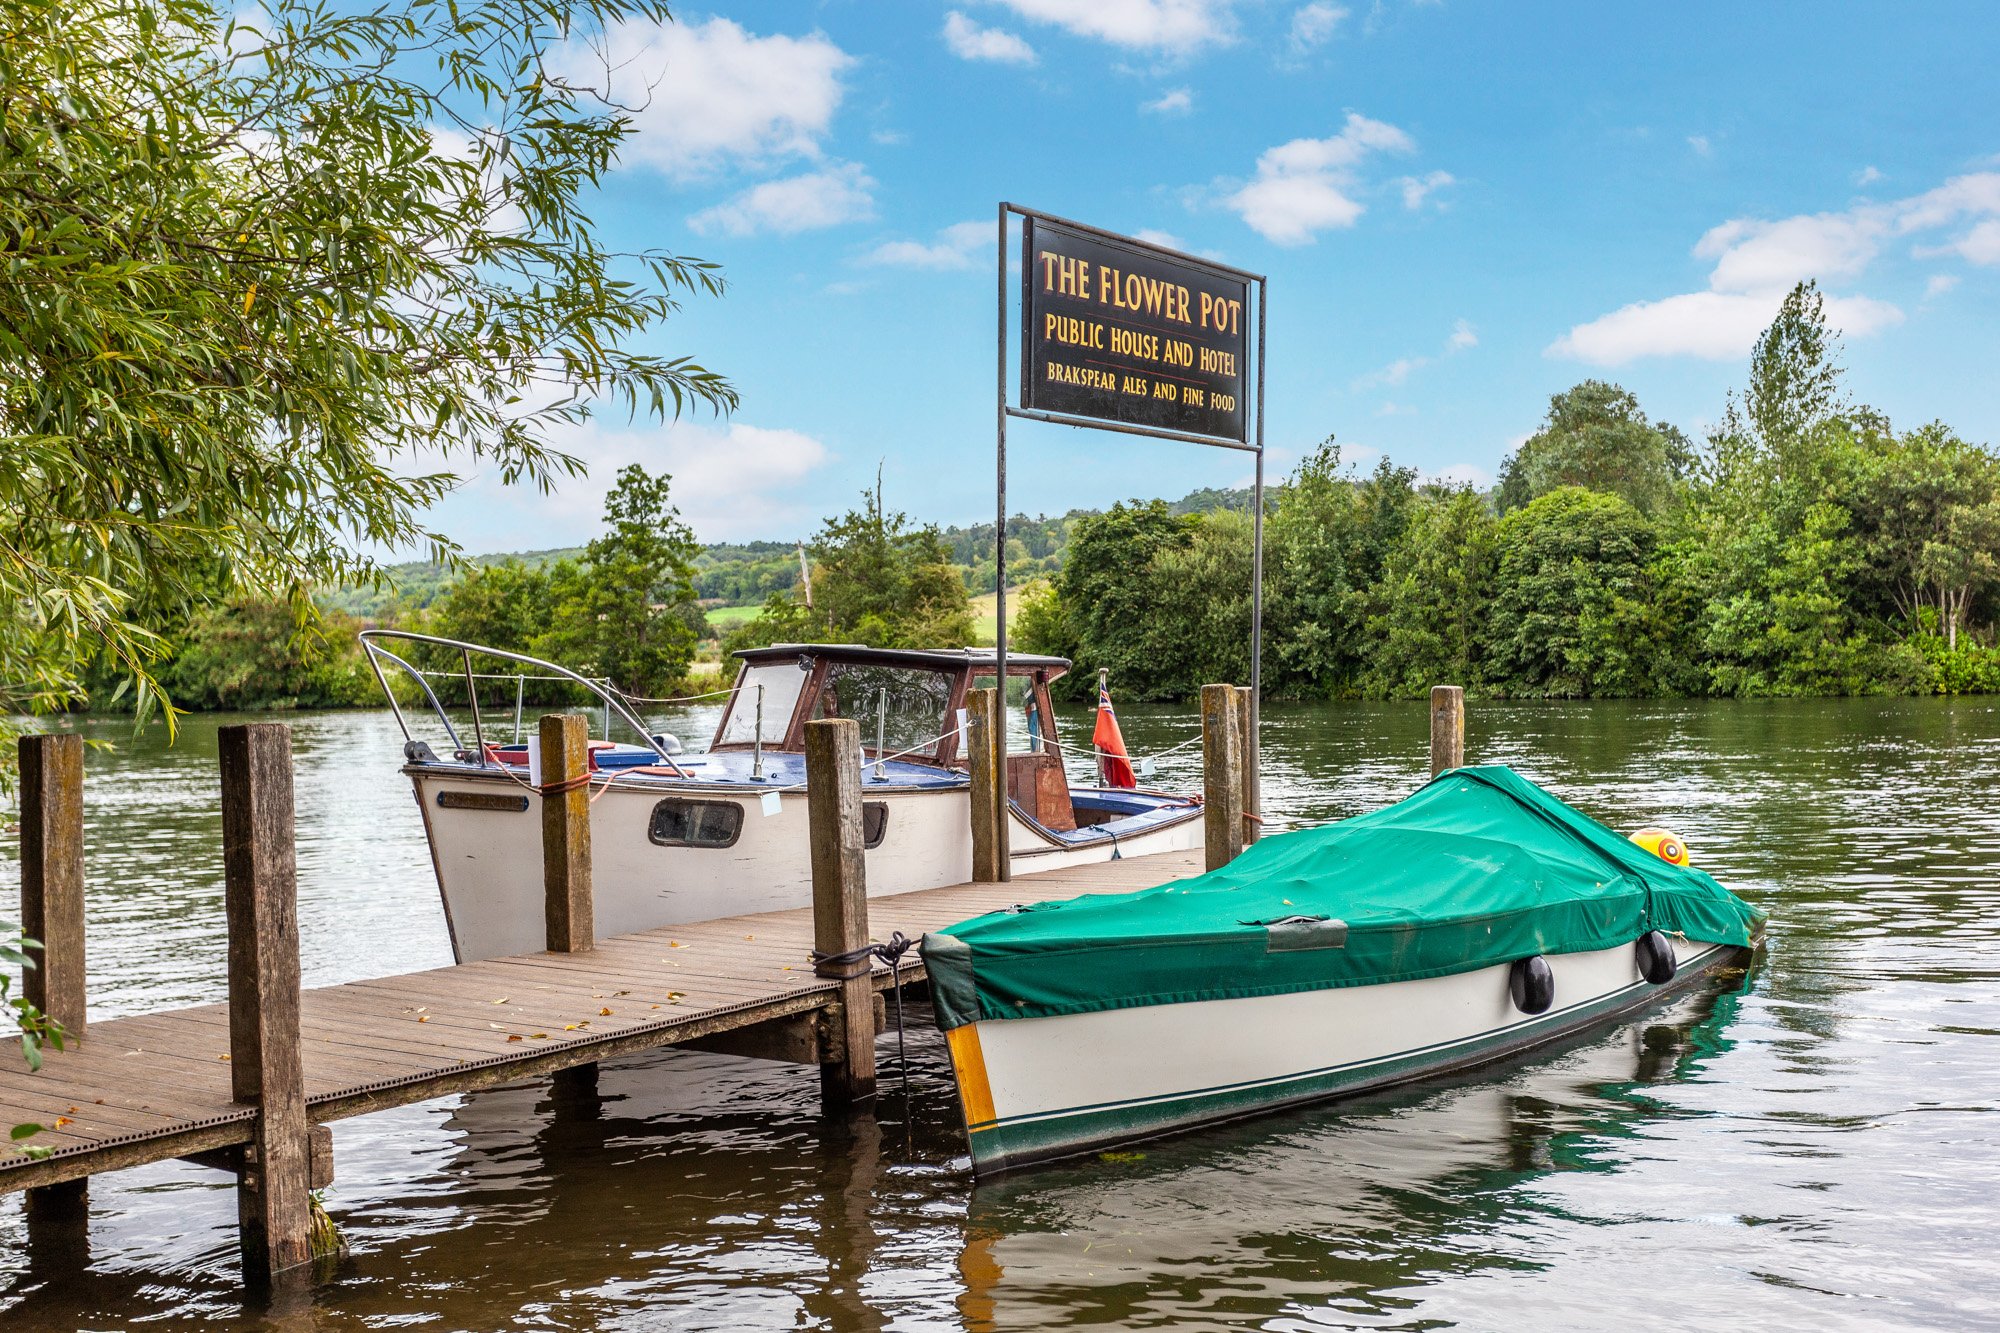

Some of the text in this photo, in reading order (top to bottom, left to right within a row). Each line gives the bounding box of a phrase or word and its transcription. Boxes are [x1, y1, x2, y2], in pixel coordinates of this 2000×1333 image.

[1039, 251, 1241, 335] THE FLOWER POT
[1045, 313, 1237, 377] PUBLIC HOUSE AND HOTEL
[1048, 361, 1236, 412] BRAKSPEAR ALES AND FINE FOOD
